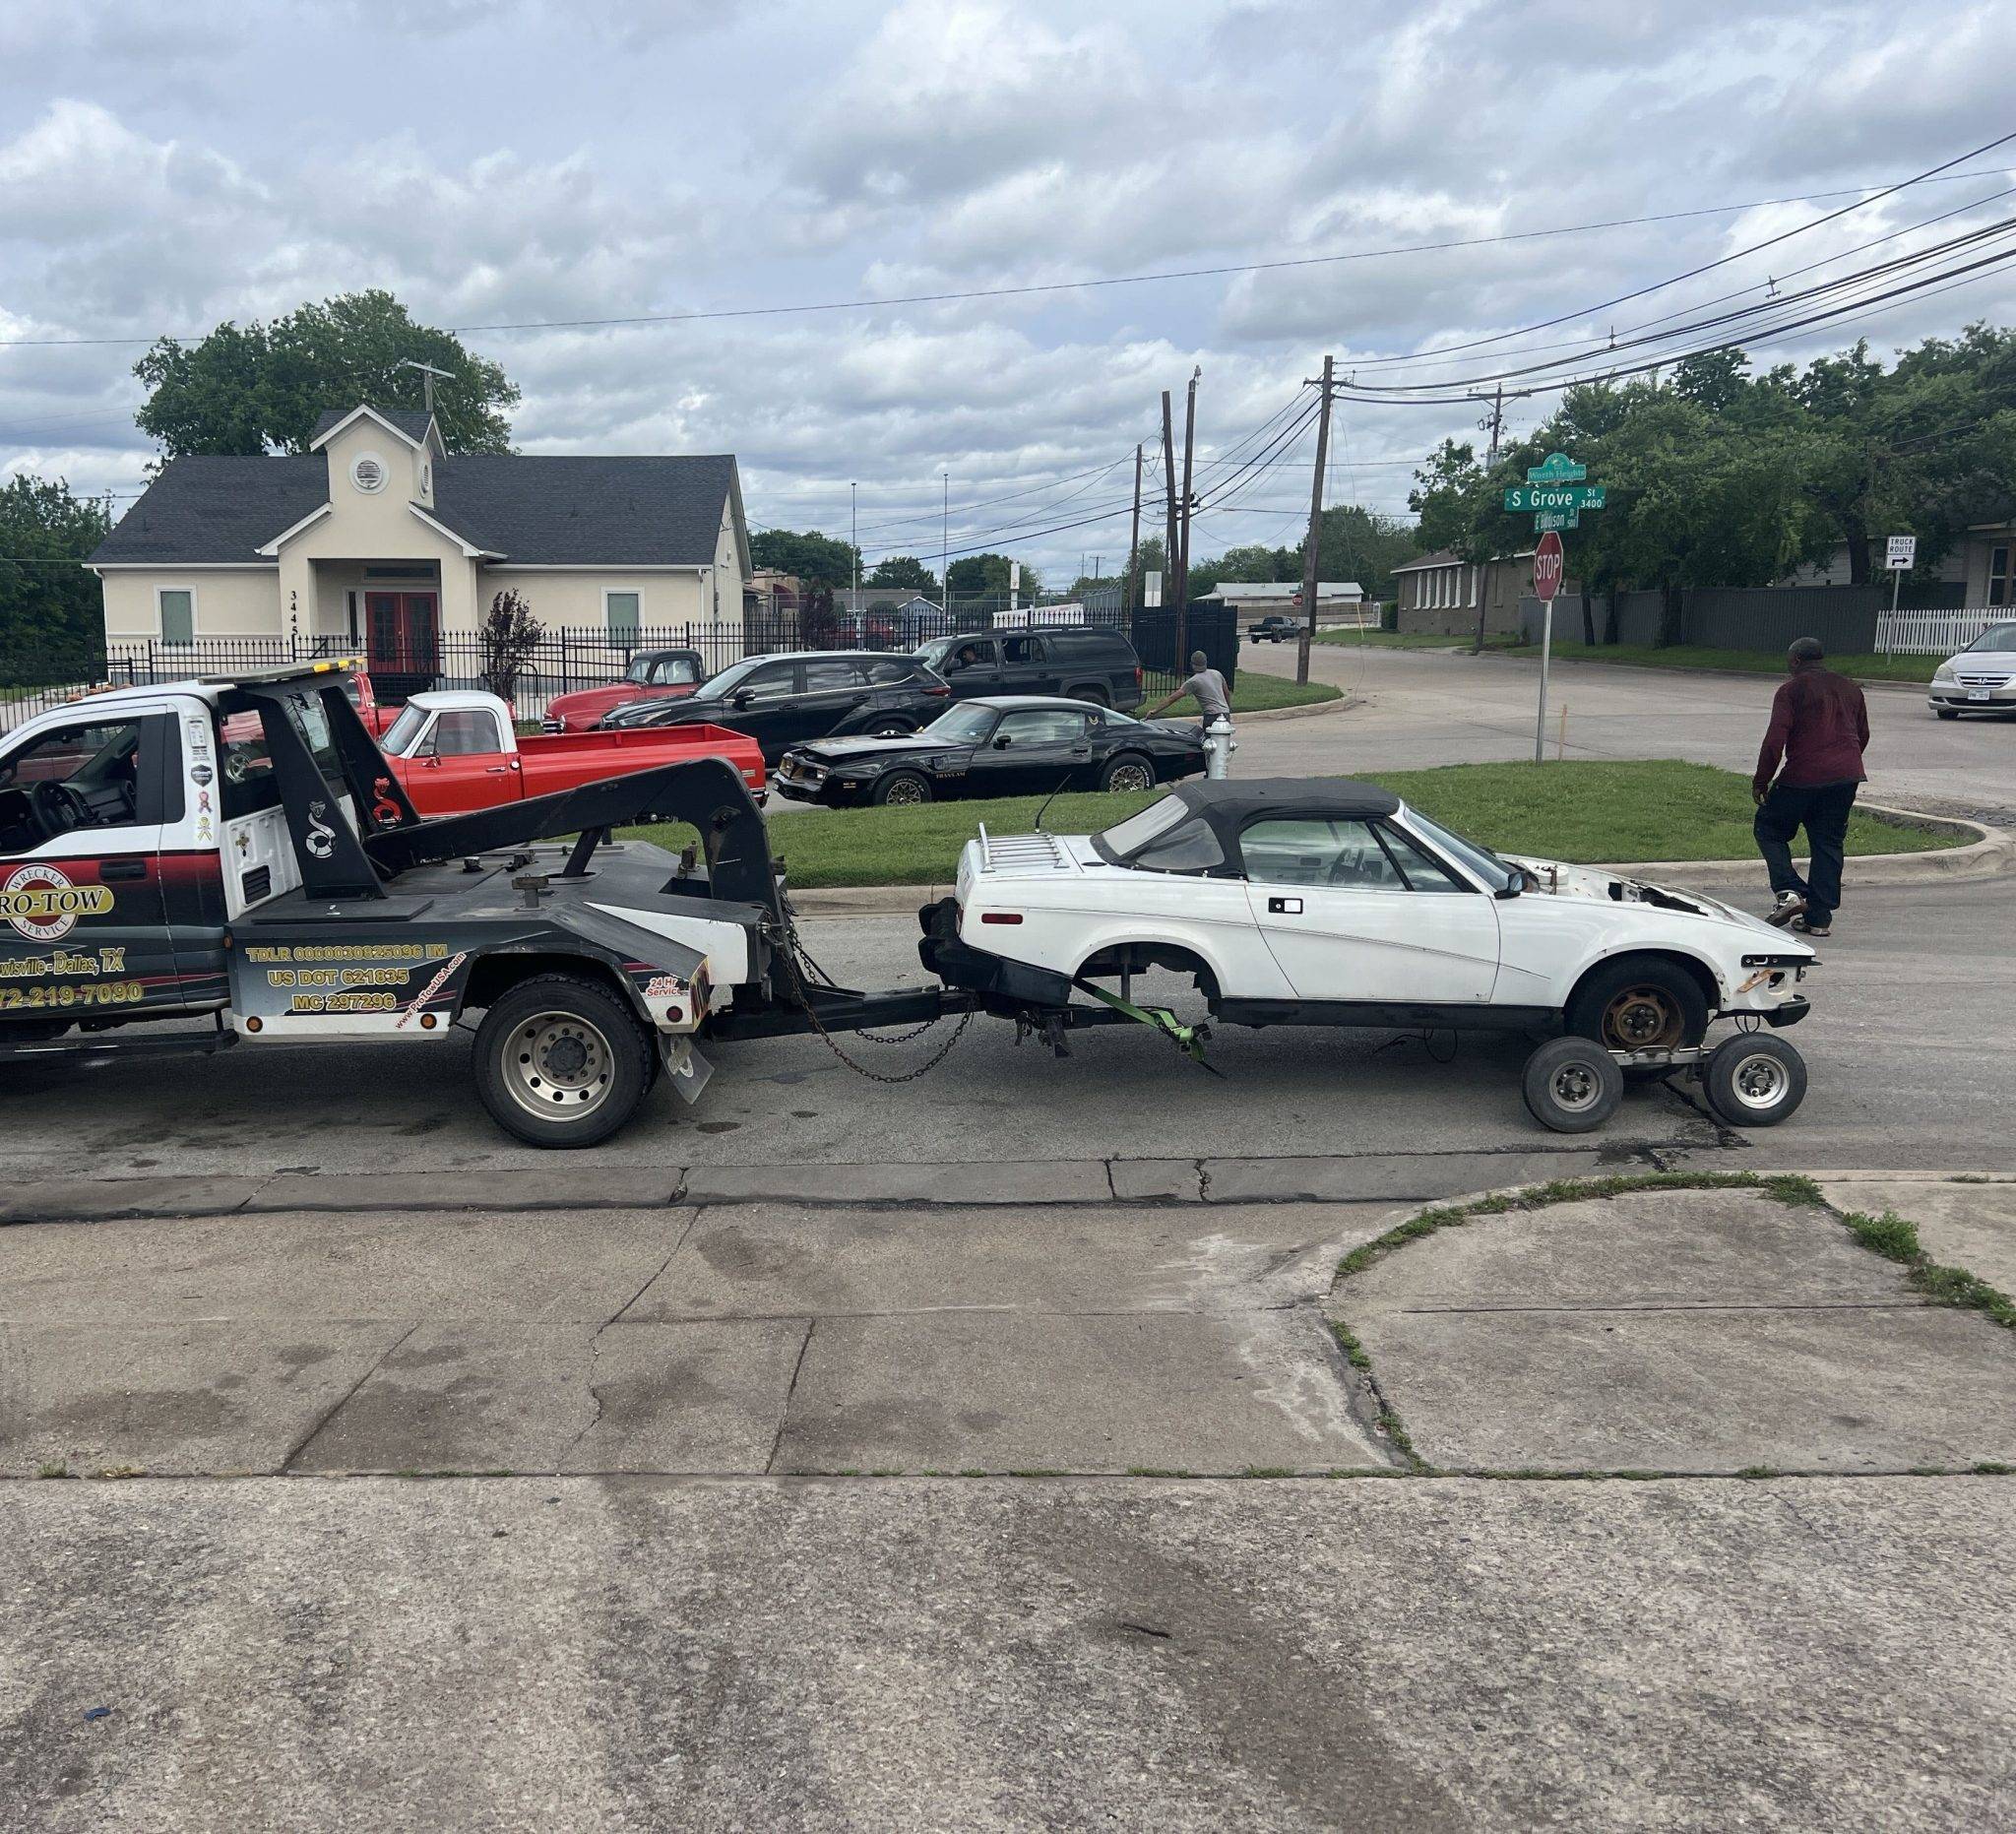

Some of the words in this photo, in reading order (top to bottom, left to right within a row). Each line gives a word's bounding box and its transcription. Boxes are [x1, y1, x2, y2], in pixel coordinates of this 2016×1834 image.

[1512, 491, 1522, 507] S
[1531, 490, 1573, 507] Grove
[1587, 488, 1597, 497] St
[1580, 499, 1603, 508] 3400
[1537, 553, 1560, 581] STOP
[289, 590, 298, 636] 3445
[11, 868, 65, 890] WRECKER
[21, 917, 70, 937] SERVICE
[0, 957, 45, 978] wisville
[99, 947, 126, 973] TX
[245, 947, 293, 963] TDLR
[425, 943, 448, 959] IM
[267, 970, 295, 986] US
[297, 969, 340, 986] DOT
[341, 968, 410, 985] 621835
[650, 978, 662, 988] 24
[663, 978, 677, 987] Hr
[291, 993, 325, 1012] MC
[325, 992, 397, 1011] 297296
